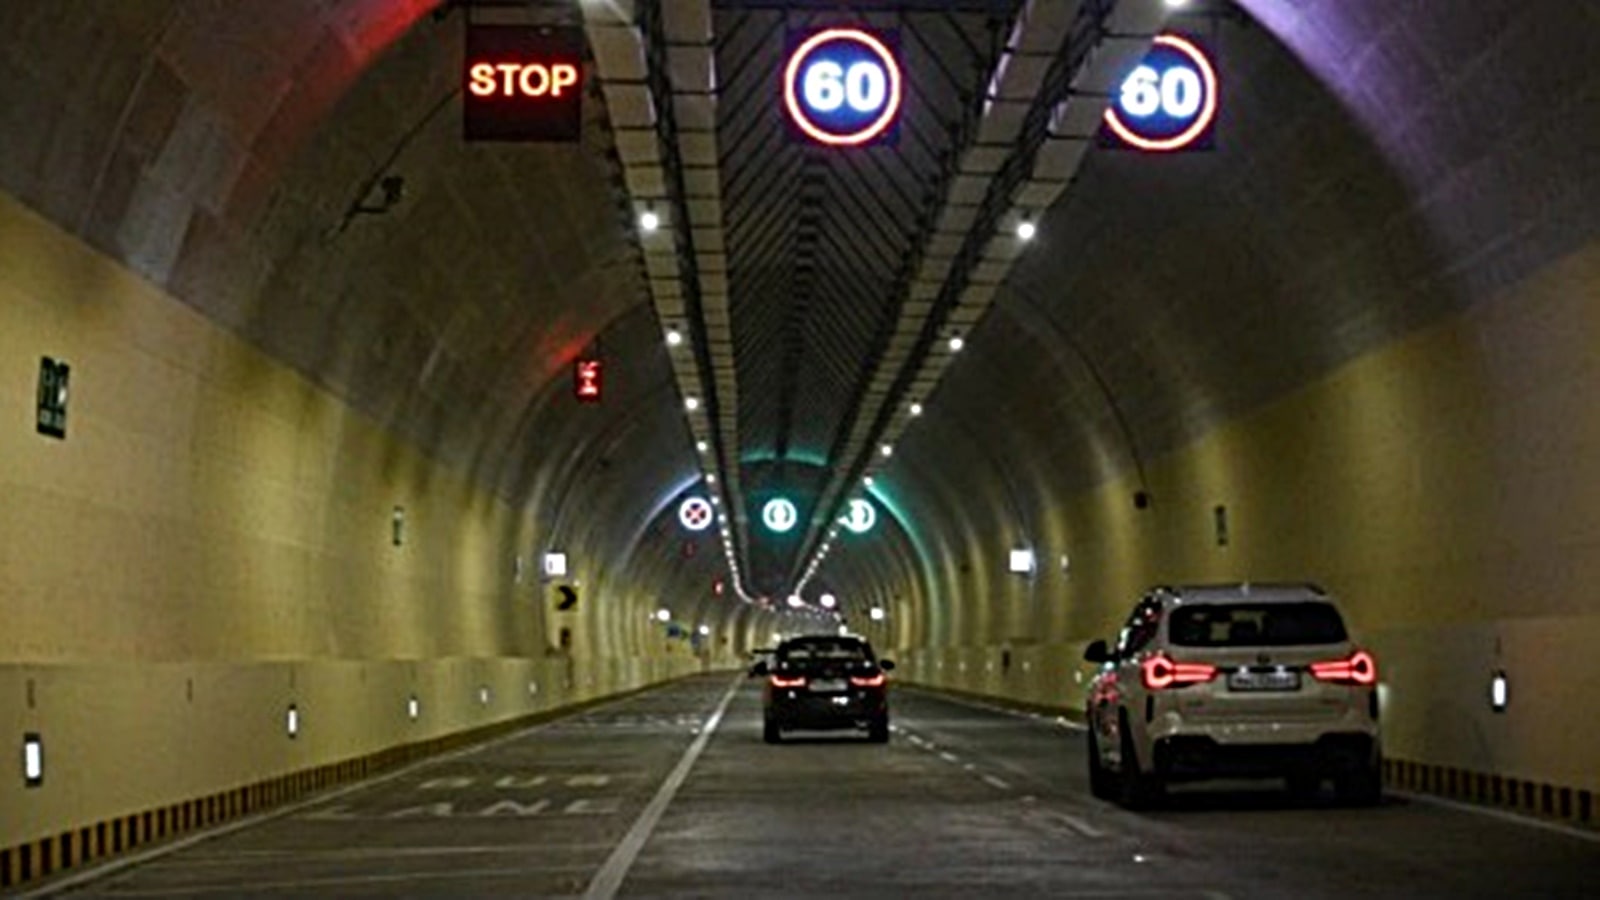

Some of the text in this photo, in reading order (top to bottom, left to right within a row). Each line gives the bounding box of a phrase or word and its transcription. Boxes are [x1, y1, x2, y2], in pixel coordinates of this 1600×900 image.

[469, 62, 578, 98] STOP
[803, 61, 887, 111] 60
[1120, 66, 1202, 117] 60
